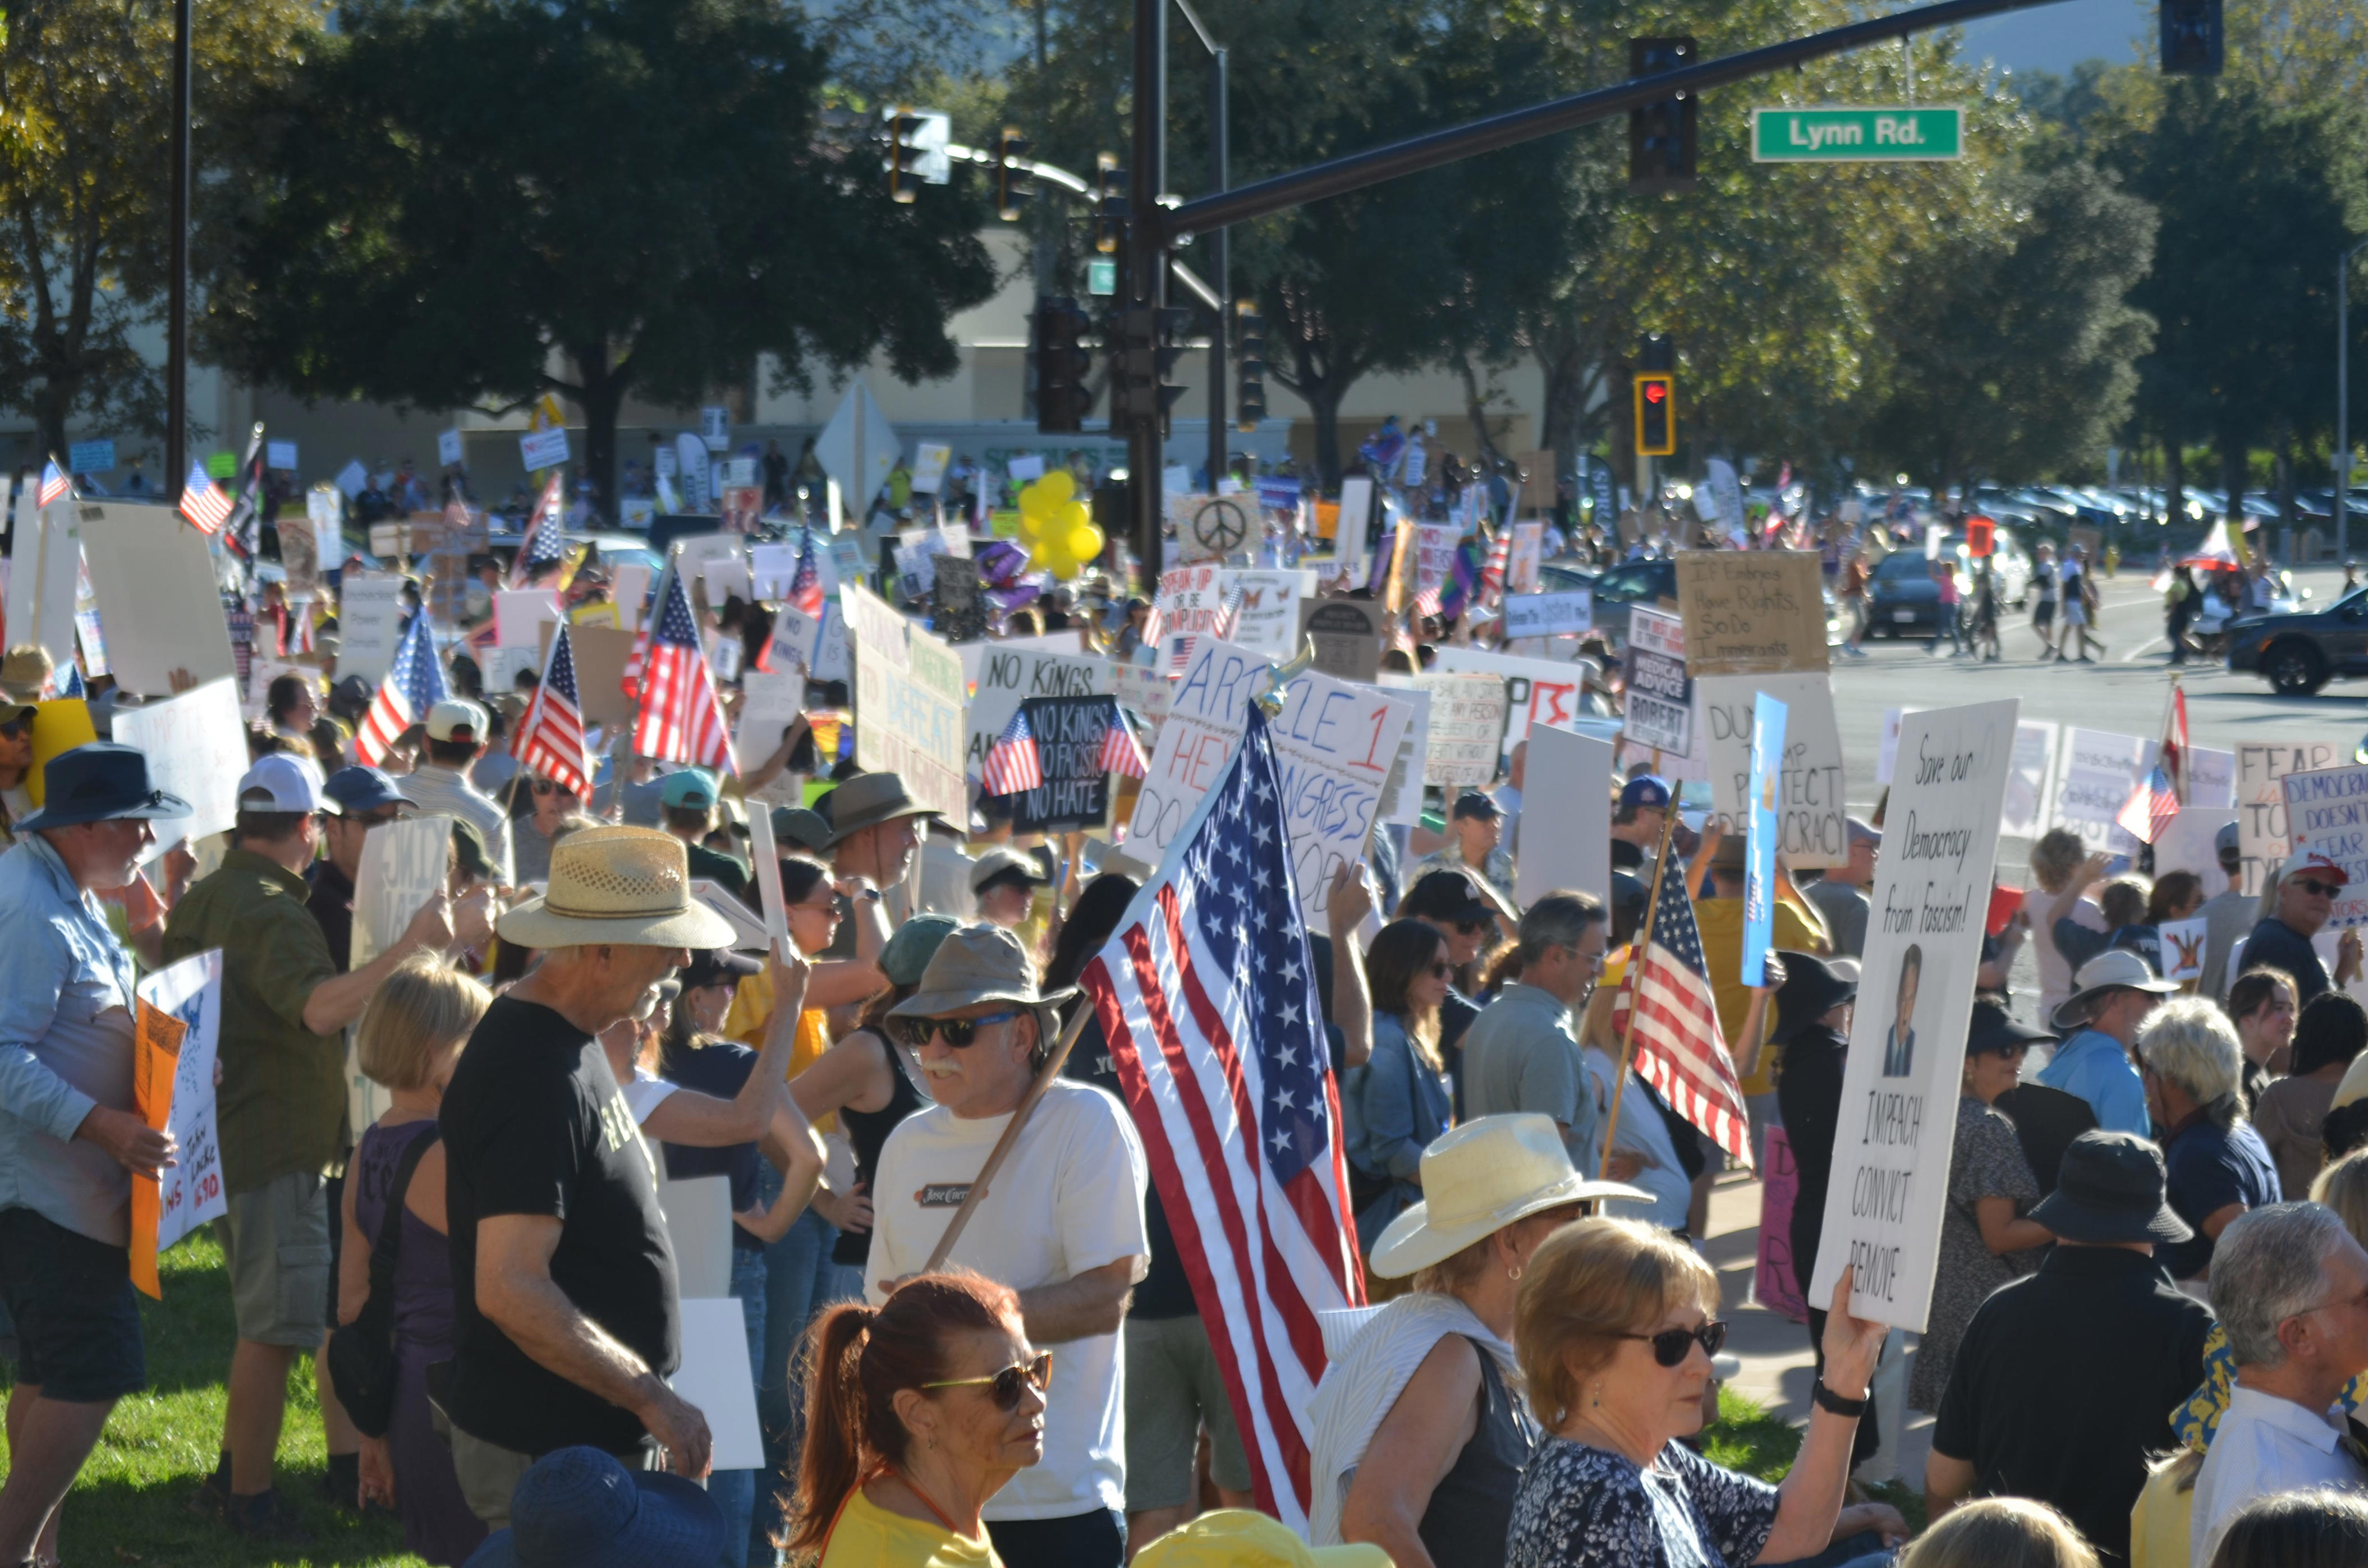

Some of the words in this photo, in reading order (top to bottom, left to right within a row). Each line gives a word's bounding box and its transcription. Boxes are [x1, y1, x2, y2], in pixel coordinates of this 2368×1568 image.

[1789, 118, 1862, 150] Lynn
[1875, 117, 1925, 145] Rd.
[1339, 562, 1360, 574] YS
[1724, 562, 1782, 587] Embryos
[1173, 594, 1186, 610] OR
[1189, 593, 1201, 608] BE
[1694, 589, 1731, 610] Have
[1737, 585, 1800, 617] Rights,
[787, 615, 801, 636] NO
[1160, 608, 1213, 636] COMPLICIT
[771, 640, 804, 666] KINGS
[1693, 636, 1789, 658] Immigrants
[986, 653, 1022, 690] NO
[1634, 655, 1685, 682] MEDICAL
[1634, 670, 1685, 698] ADVICE
[885, 668, 955, 765] DEFEAT
[1034, 705, 1057, 742] NO
[1174, 648, 1355, 753] ARTCLE
[1348, 705, 1389, 774] 1
[1630, 694, 1685, 736] ROBERT
[1709, 705, 1755, 741] DU
[1742, 742, 1807, 769] TMP
[1915, 733, 1945, 785] Save
[1951, 752, 1974, 782] our
[2241, 746, 2332, 783] FEAR
[1027, 781, 1050, 822] NO
[1053, 780, 1100, 817] HATE
[1277, 758, 1376, 841] NGRESS
[1733, 765, 1839, 808] PTECT
[2287, 772, 2368, 804] DEMOCRA
[1718, 810, 1846, 856] DEOCRACY
[1901, 809, 1971, 874] Democracy
[1883, 882, 1913, 934] from
[1919, 881, 1972, 935] Fascism!
[1862, 1090, 1924, 1150] IMPEACH
[194, 1172, 219, 1211] 1690
[923, 1188, 944, 1204] Jose
[945, 1187, 971, 1203] Cuer
[1852, 1165, 1912, 1225] CONVICT
[1850, 1240, 1901, 1303] REMOVE
